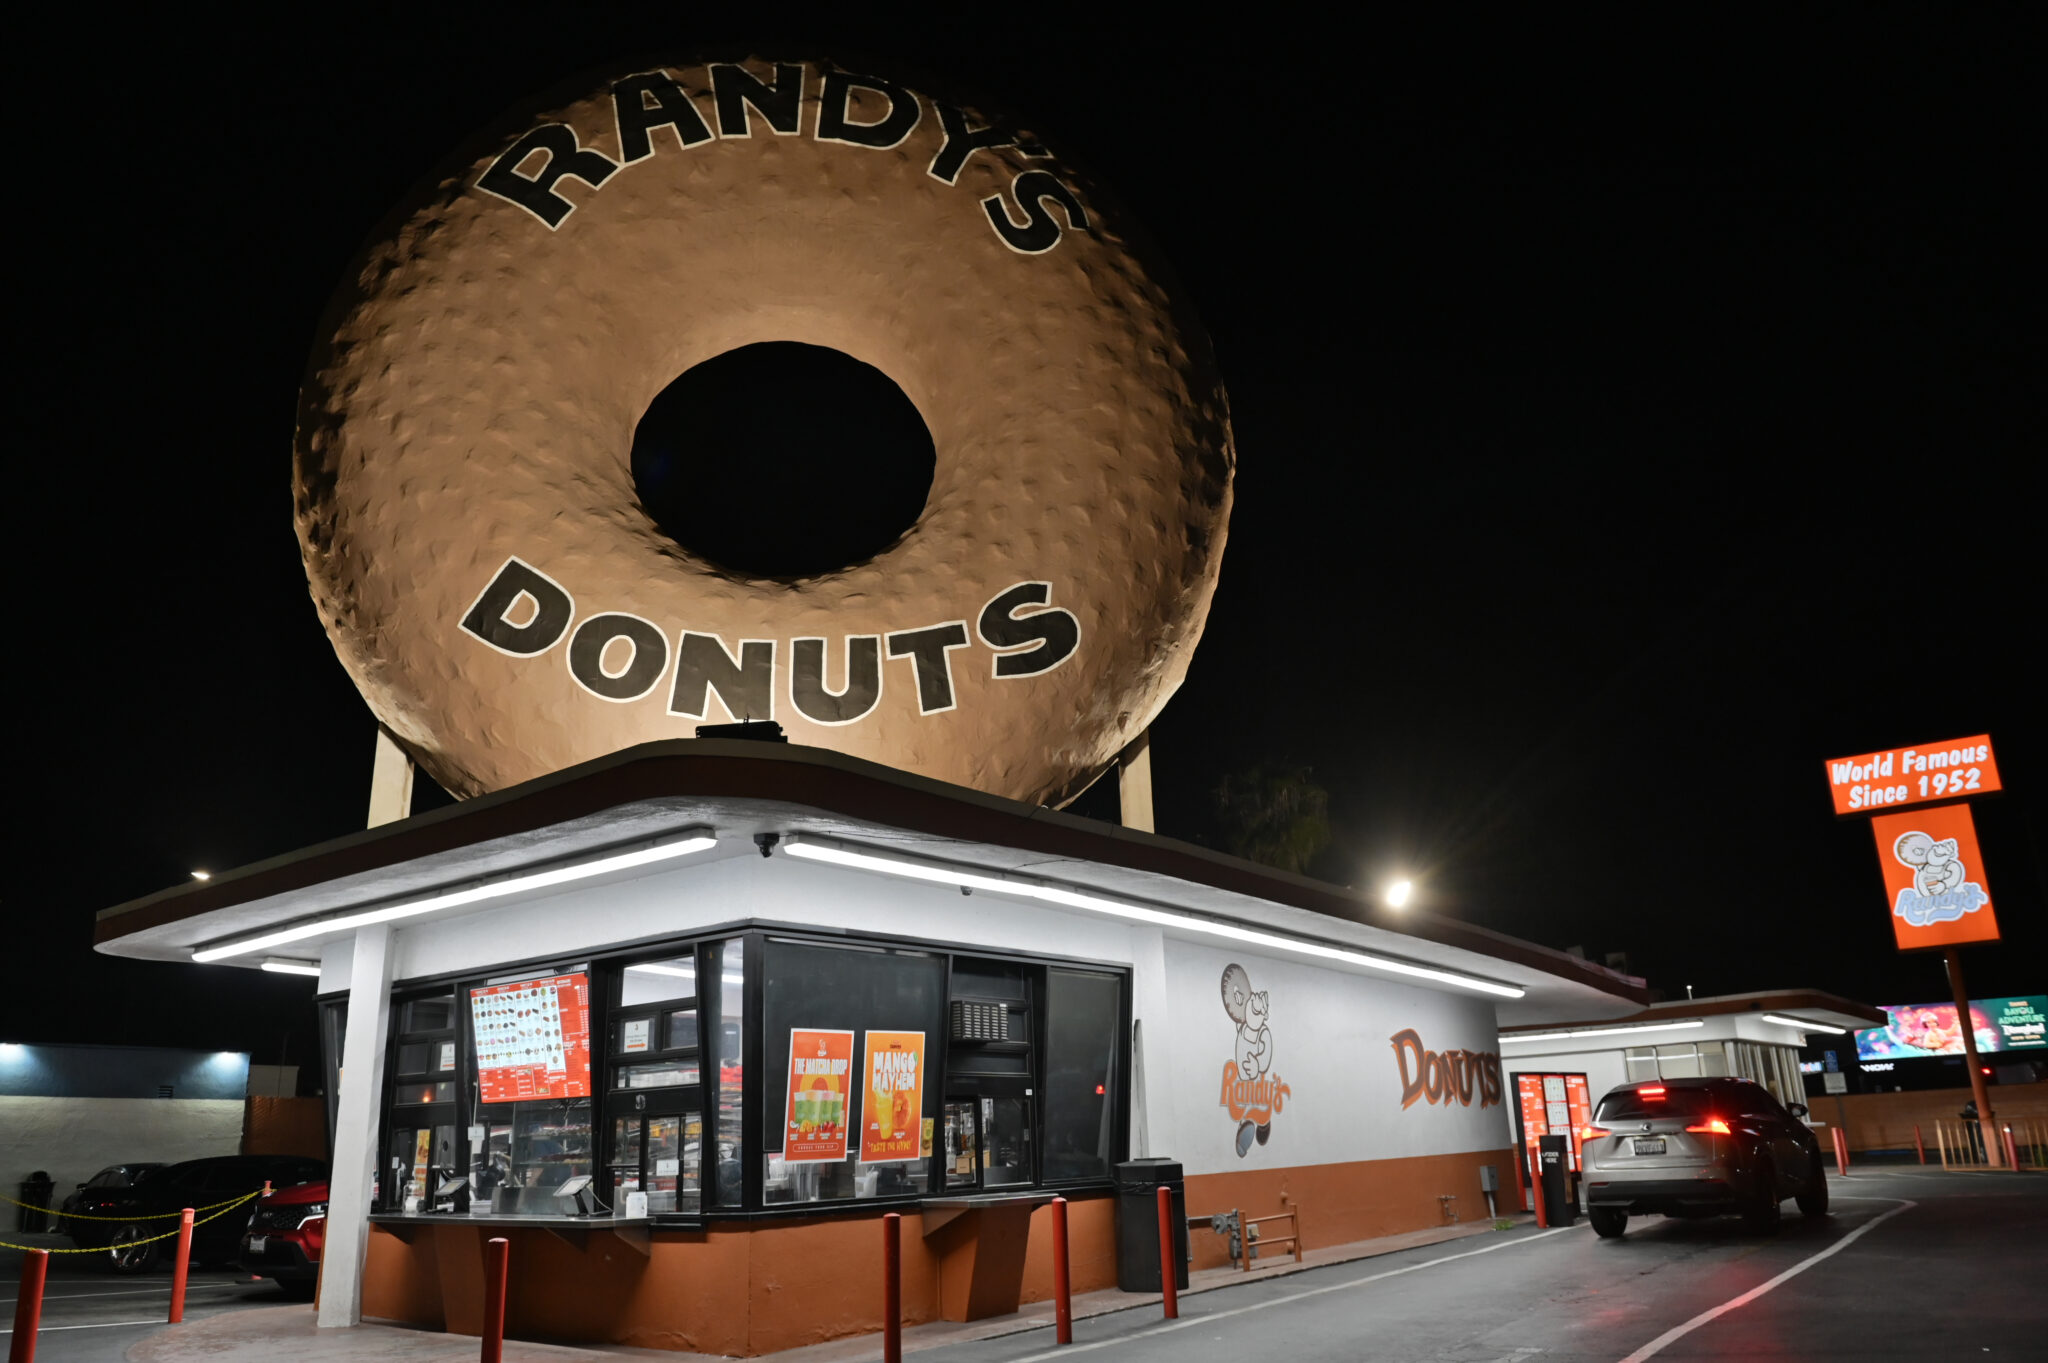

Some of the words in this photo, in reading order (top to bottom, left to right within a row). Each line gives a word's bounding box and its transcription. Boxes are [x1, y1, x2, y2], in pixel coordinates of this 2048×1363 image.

[473, 62, 1090, 254] RANDY'S
[457, 555, 1081, 726] DONUTS
[1832, 752, 1894, 785] World
[1902, 745, 1989, 775] Famous
[1848, 785, 1908, 809] Since
[1917, 767, 1982, 797] 1952
[794, 1058, 806, 1075] THE
[806, 1058, 831, 1075] MATCHA
[831, 1058, 848, 1076] DROP
[871, 1072, 916, 1092] MAYHEM
[873, 1051, 918, 1073] MANGO
[1389, 1028, 1500, 1111] DONUTS
[1219, 1059, 1291, 1125] Randy's
